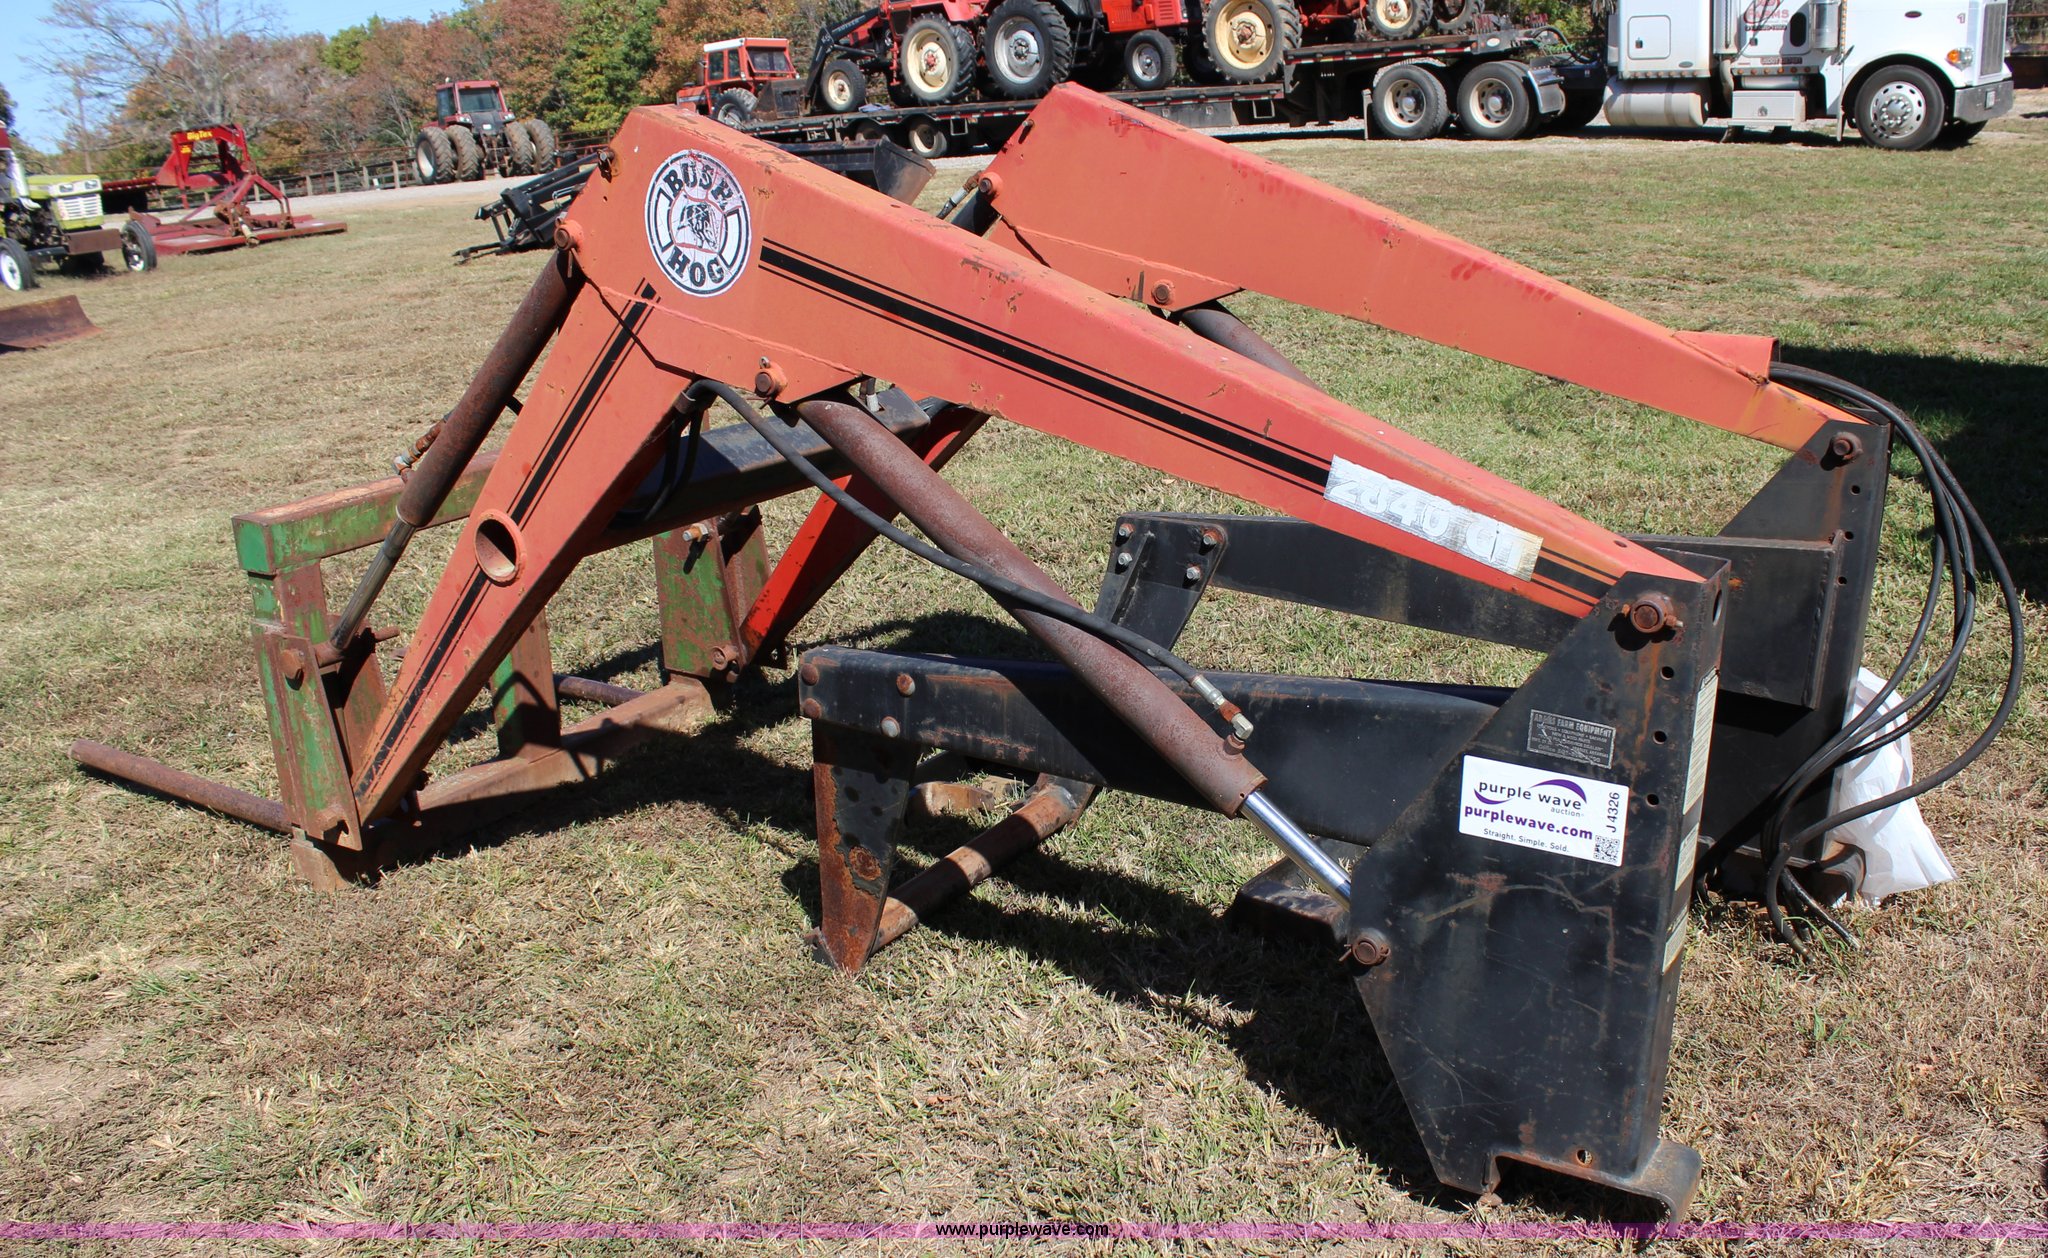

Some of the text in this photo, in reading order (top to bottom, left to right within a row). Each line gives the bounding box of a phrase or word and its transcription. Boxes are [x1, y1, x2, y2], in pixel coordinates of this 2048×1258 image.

[663, 161, 734, 212] BUSH
[667, 246, 725, 287] HOG
[1575, 722, 1611, 738] EQUIPMENT
[1479, 781, 1582, 810] purple wave
[1464, 805, 1593, 840] purplewave.com
[1550, 806, 1581, 818] auction
[1606, 792, 1620, 833] J 4326
[1483, 828, 1570, 852] Straight. Simple. Sold.
